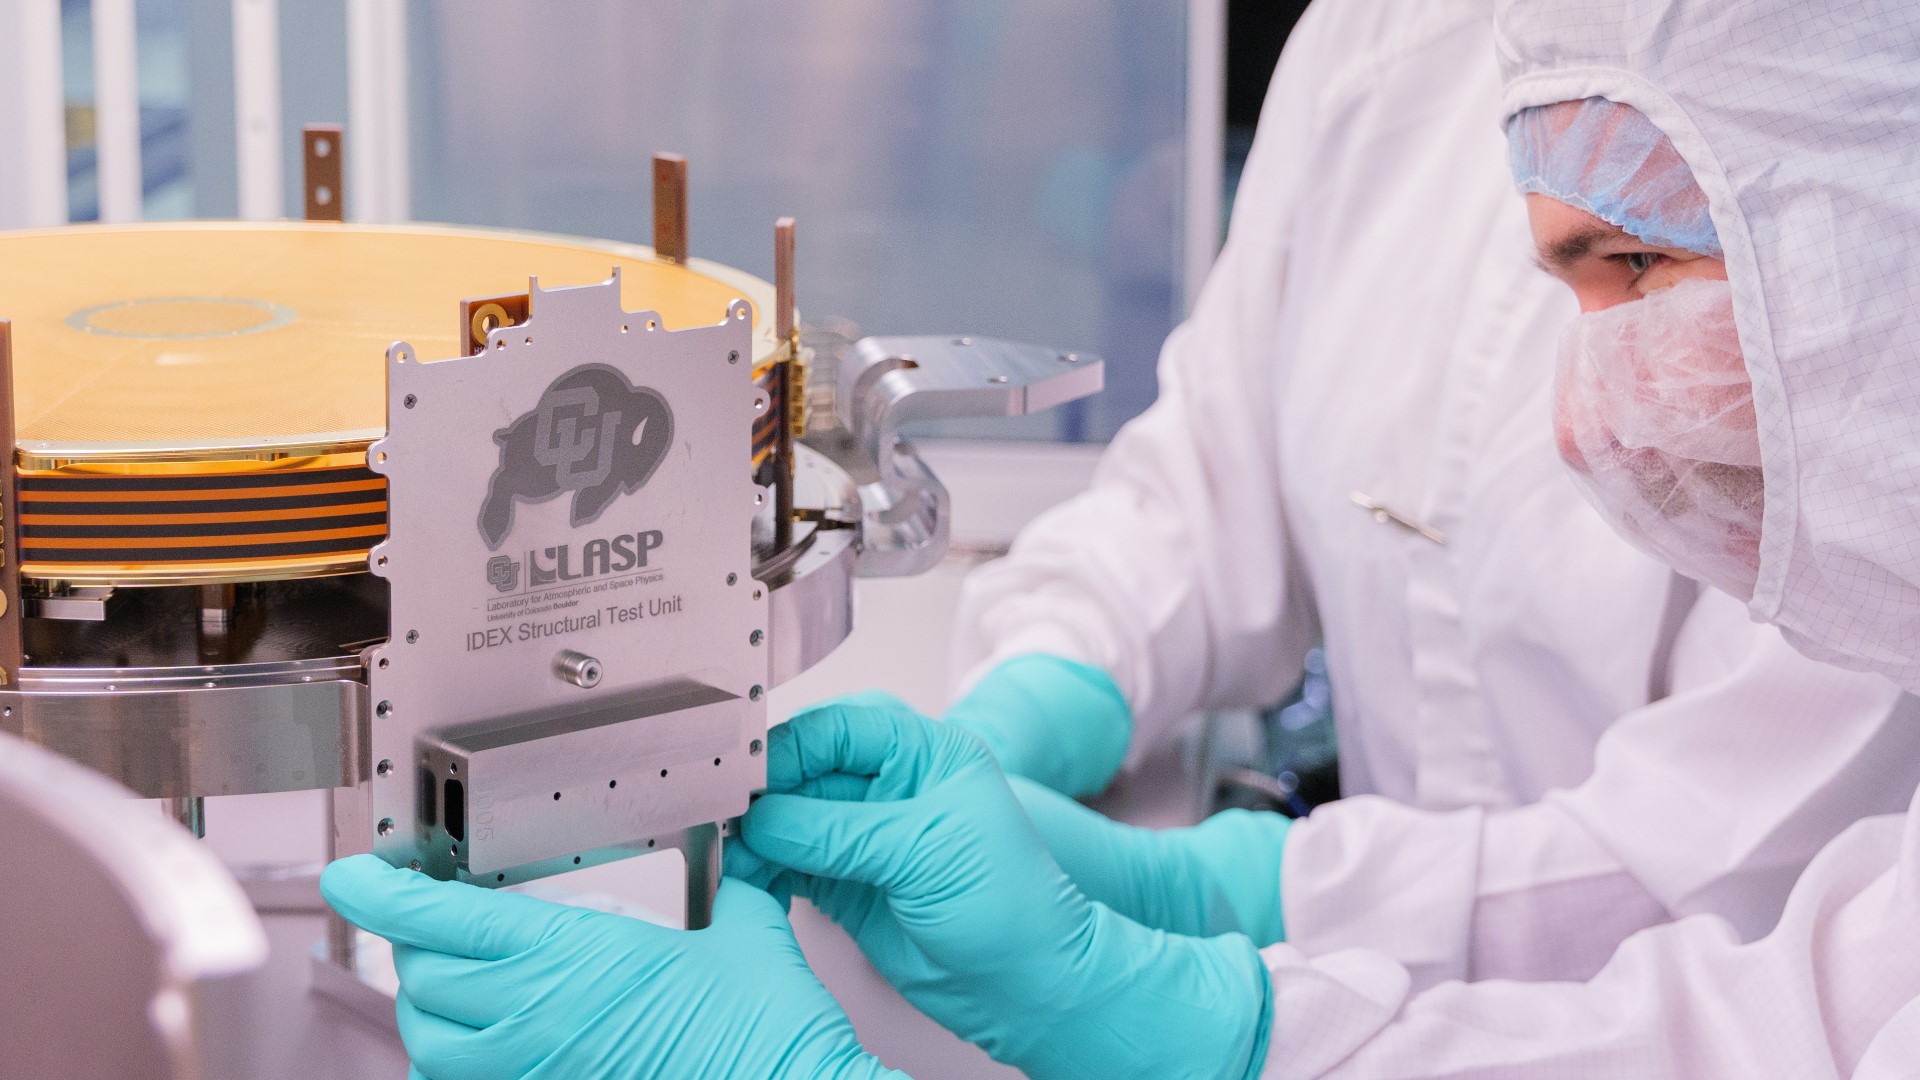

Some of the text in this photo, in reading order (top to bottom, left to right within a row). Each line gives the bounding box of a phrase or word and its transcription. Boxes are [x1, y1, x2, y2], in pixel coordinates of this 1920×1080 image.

[557, 529, 664, 581] LASP
[487, 573, 664, 612] Laboratory for Atmospheric and Space Physics
[487, 611, 516, 622] University
[524, 604, 552, 615] Colorado
[553, 600, 579, 609] Boulder
[467, 595, 682, 652] IDEX Structural Test Unit
